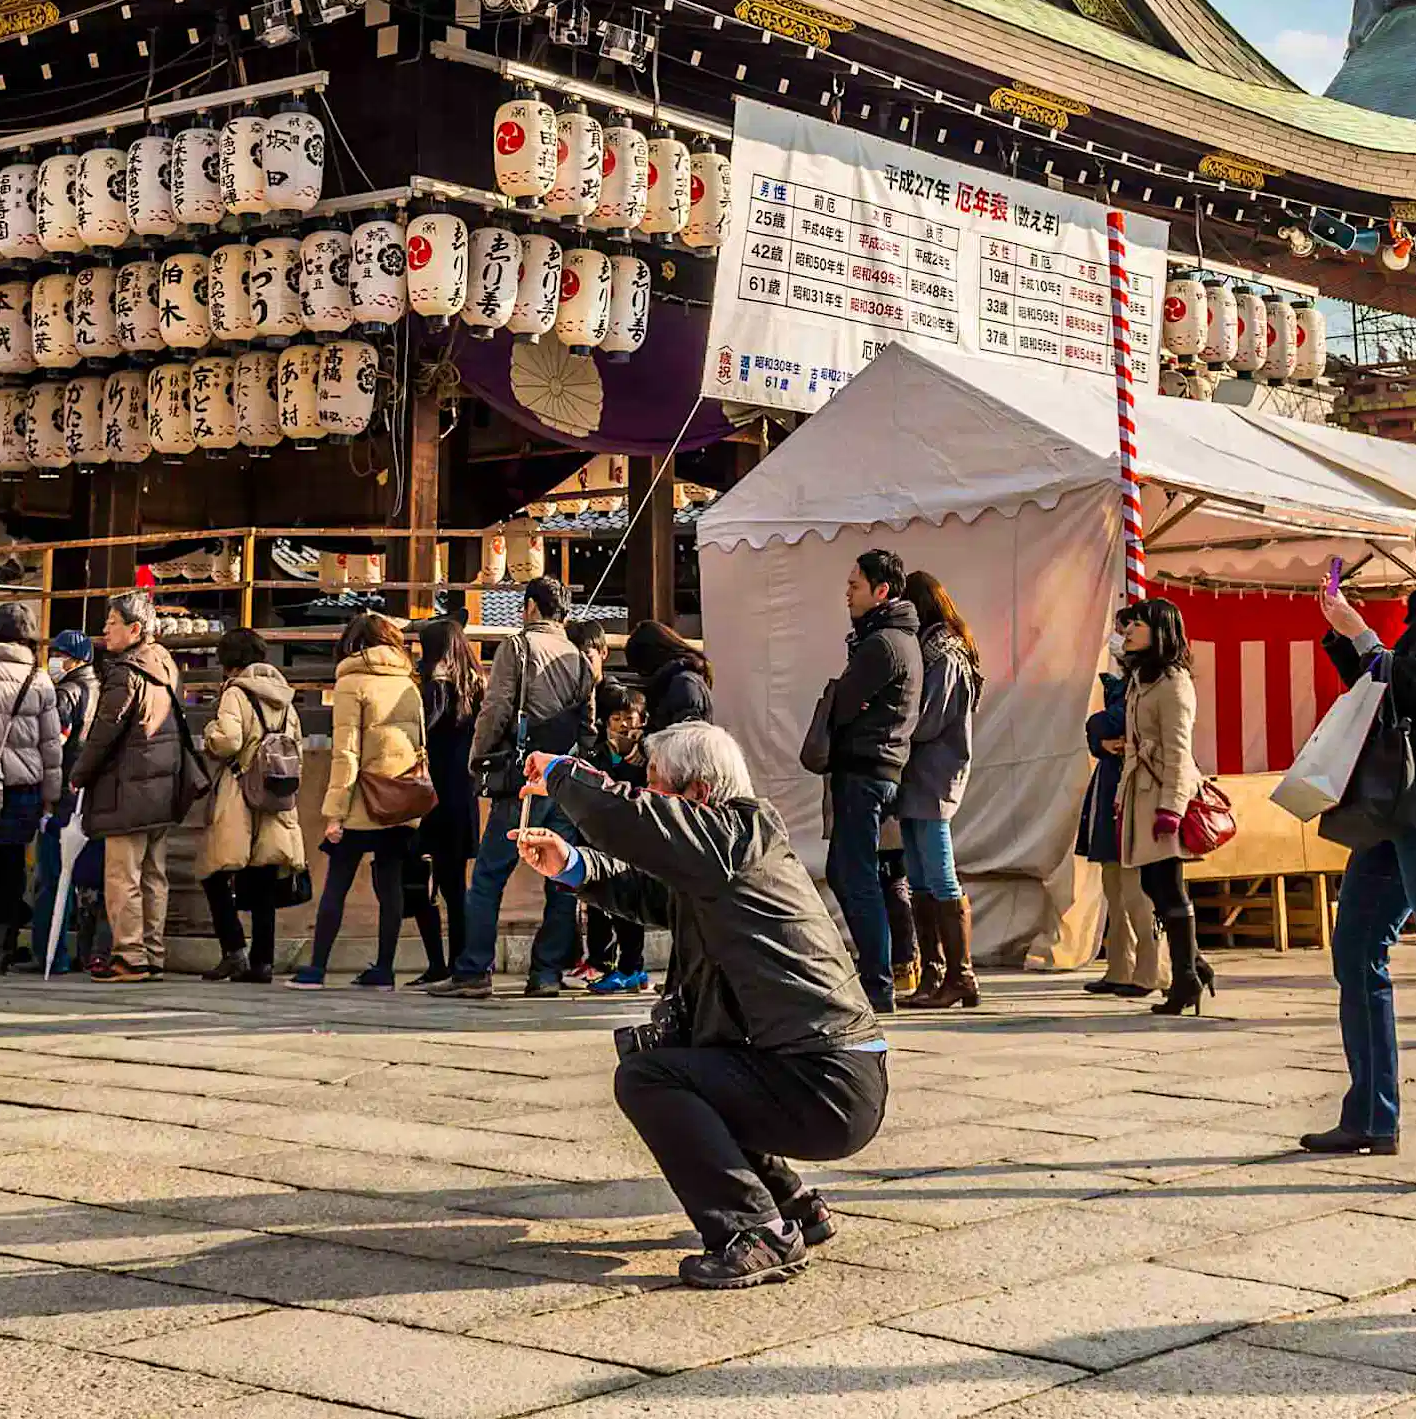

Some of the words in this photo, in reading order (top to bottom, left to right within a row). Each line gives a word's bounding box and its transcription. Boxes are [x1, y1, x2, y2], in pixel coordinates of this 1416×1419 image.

[266, 129, 292, 187] 坂田
[759, 180, 787, 201] 男性
[885, 163, 951, 206] 平成27年
[955, 181, 1009, 222] 厄年表
[755, 209, 786, 230] 25歳
[801, 218, 845, 243] 平成4年生
[751, 244, 784, 263] 42歳
[795, 251, 846, 276] 昭和50年生
[252, 248, 277, 325] いづう
[749, 276, 782, 296] 61歳
[792, 284, 844, 308] 昭和31年生
[850, 297, 904, 322] 昭和30年生
[322, 344, 344, 383] 高橋
[193, 365, 215, 439] 京とみ
[281, 358, 299, 427] あと村
